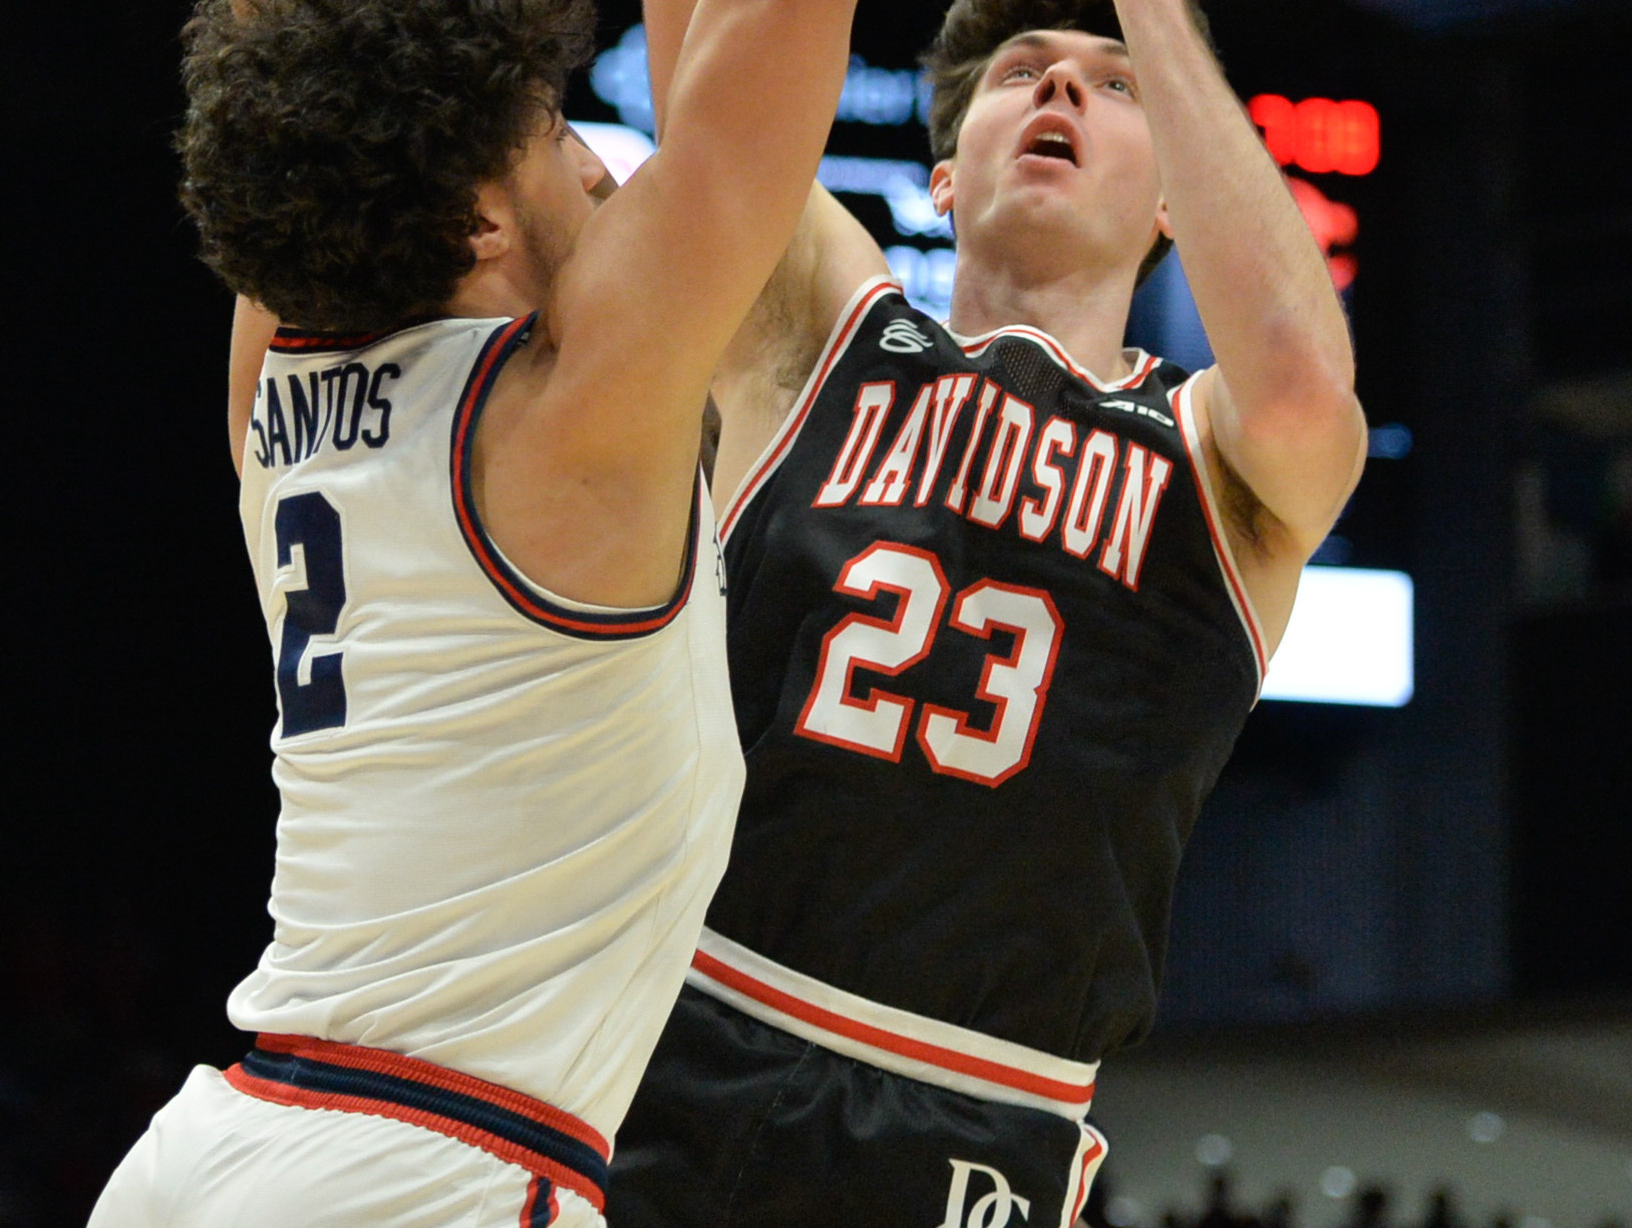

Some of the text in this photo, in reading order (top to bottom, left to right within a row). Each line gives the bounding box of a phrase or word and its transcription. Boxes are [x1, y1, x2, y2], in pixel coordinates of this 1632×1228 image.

[251, 362, 401, 468] SANTOS
[810, 372, 1173, 592] DAVIDSON
[274, 489, 347, 740] 2
[793, 539, 1065, 788] 23
